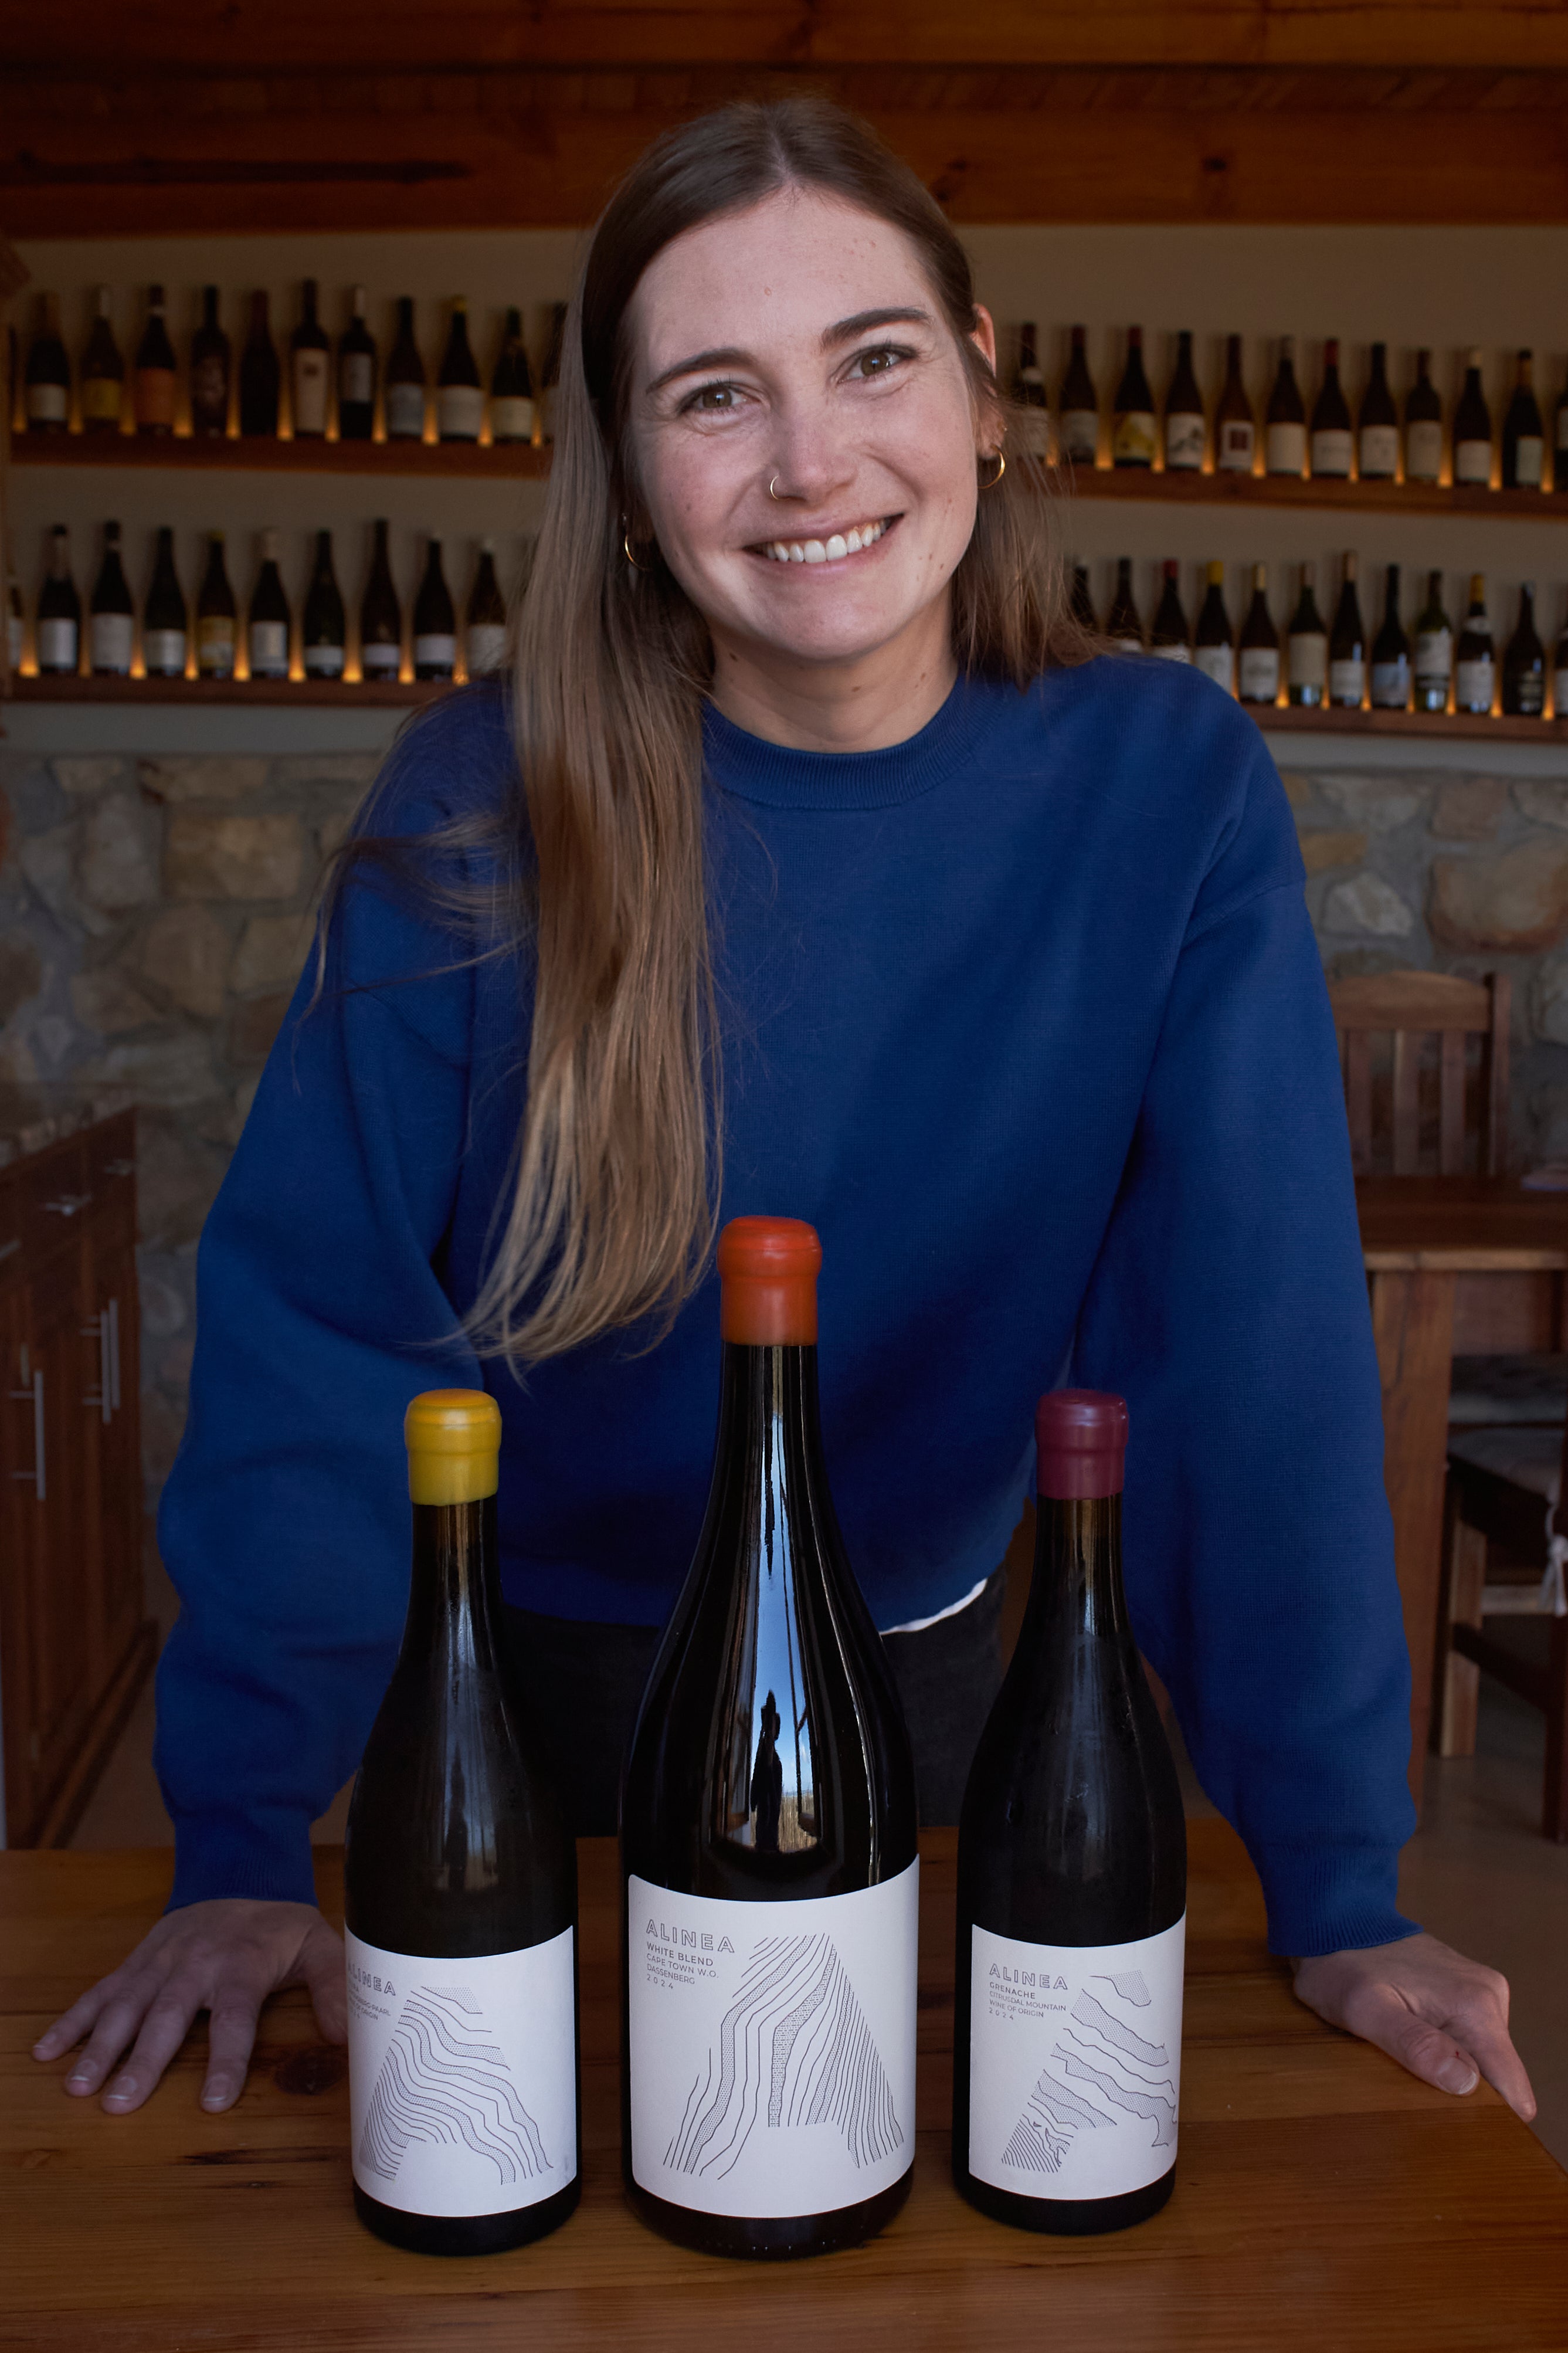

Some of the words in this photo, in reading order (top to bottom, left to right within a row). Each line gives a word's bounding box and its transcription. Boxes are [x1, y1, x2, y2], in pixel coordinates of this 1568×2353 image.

[646, 1919, 735, 1953] ALINEA
[647, 1941, 674, 1959] WHITE
[678, 1952, 713, 1967] BLEND
[647, 1953, 666, 1967] CAPE
[668, 1961, 694, 1974] TOWN
[697, 1968, 719, 1978] W.O.
[647, 1963, 695, 1985] DASSENBERG
[989, 1964, 1068, 1990] ALINEA
[989, 1981, 1036, 1999] GRENACHE
[989, 1991, 1024, 2006] CITRUSDAL
[1026, 2001, 1066, 2011] MOUNTAIN
[989, 1999, 1006, 2009] WINE
[1018, 2008, 1044, 2018] ORIGIN
